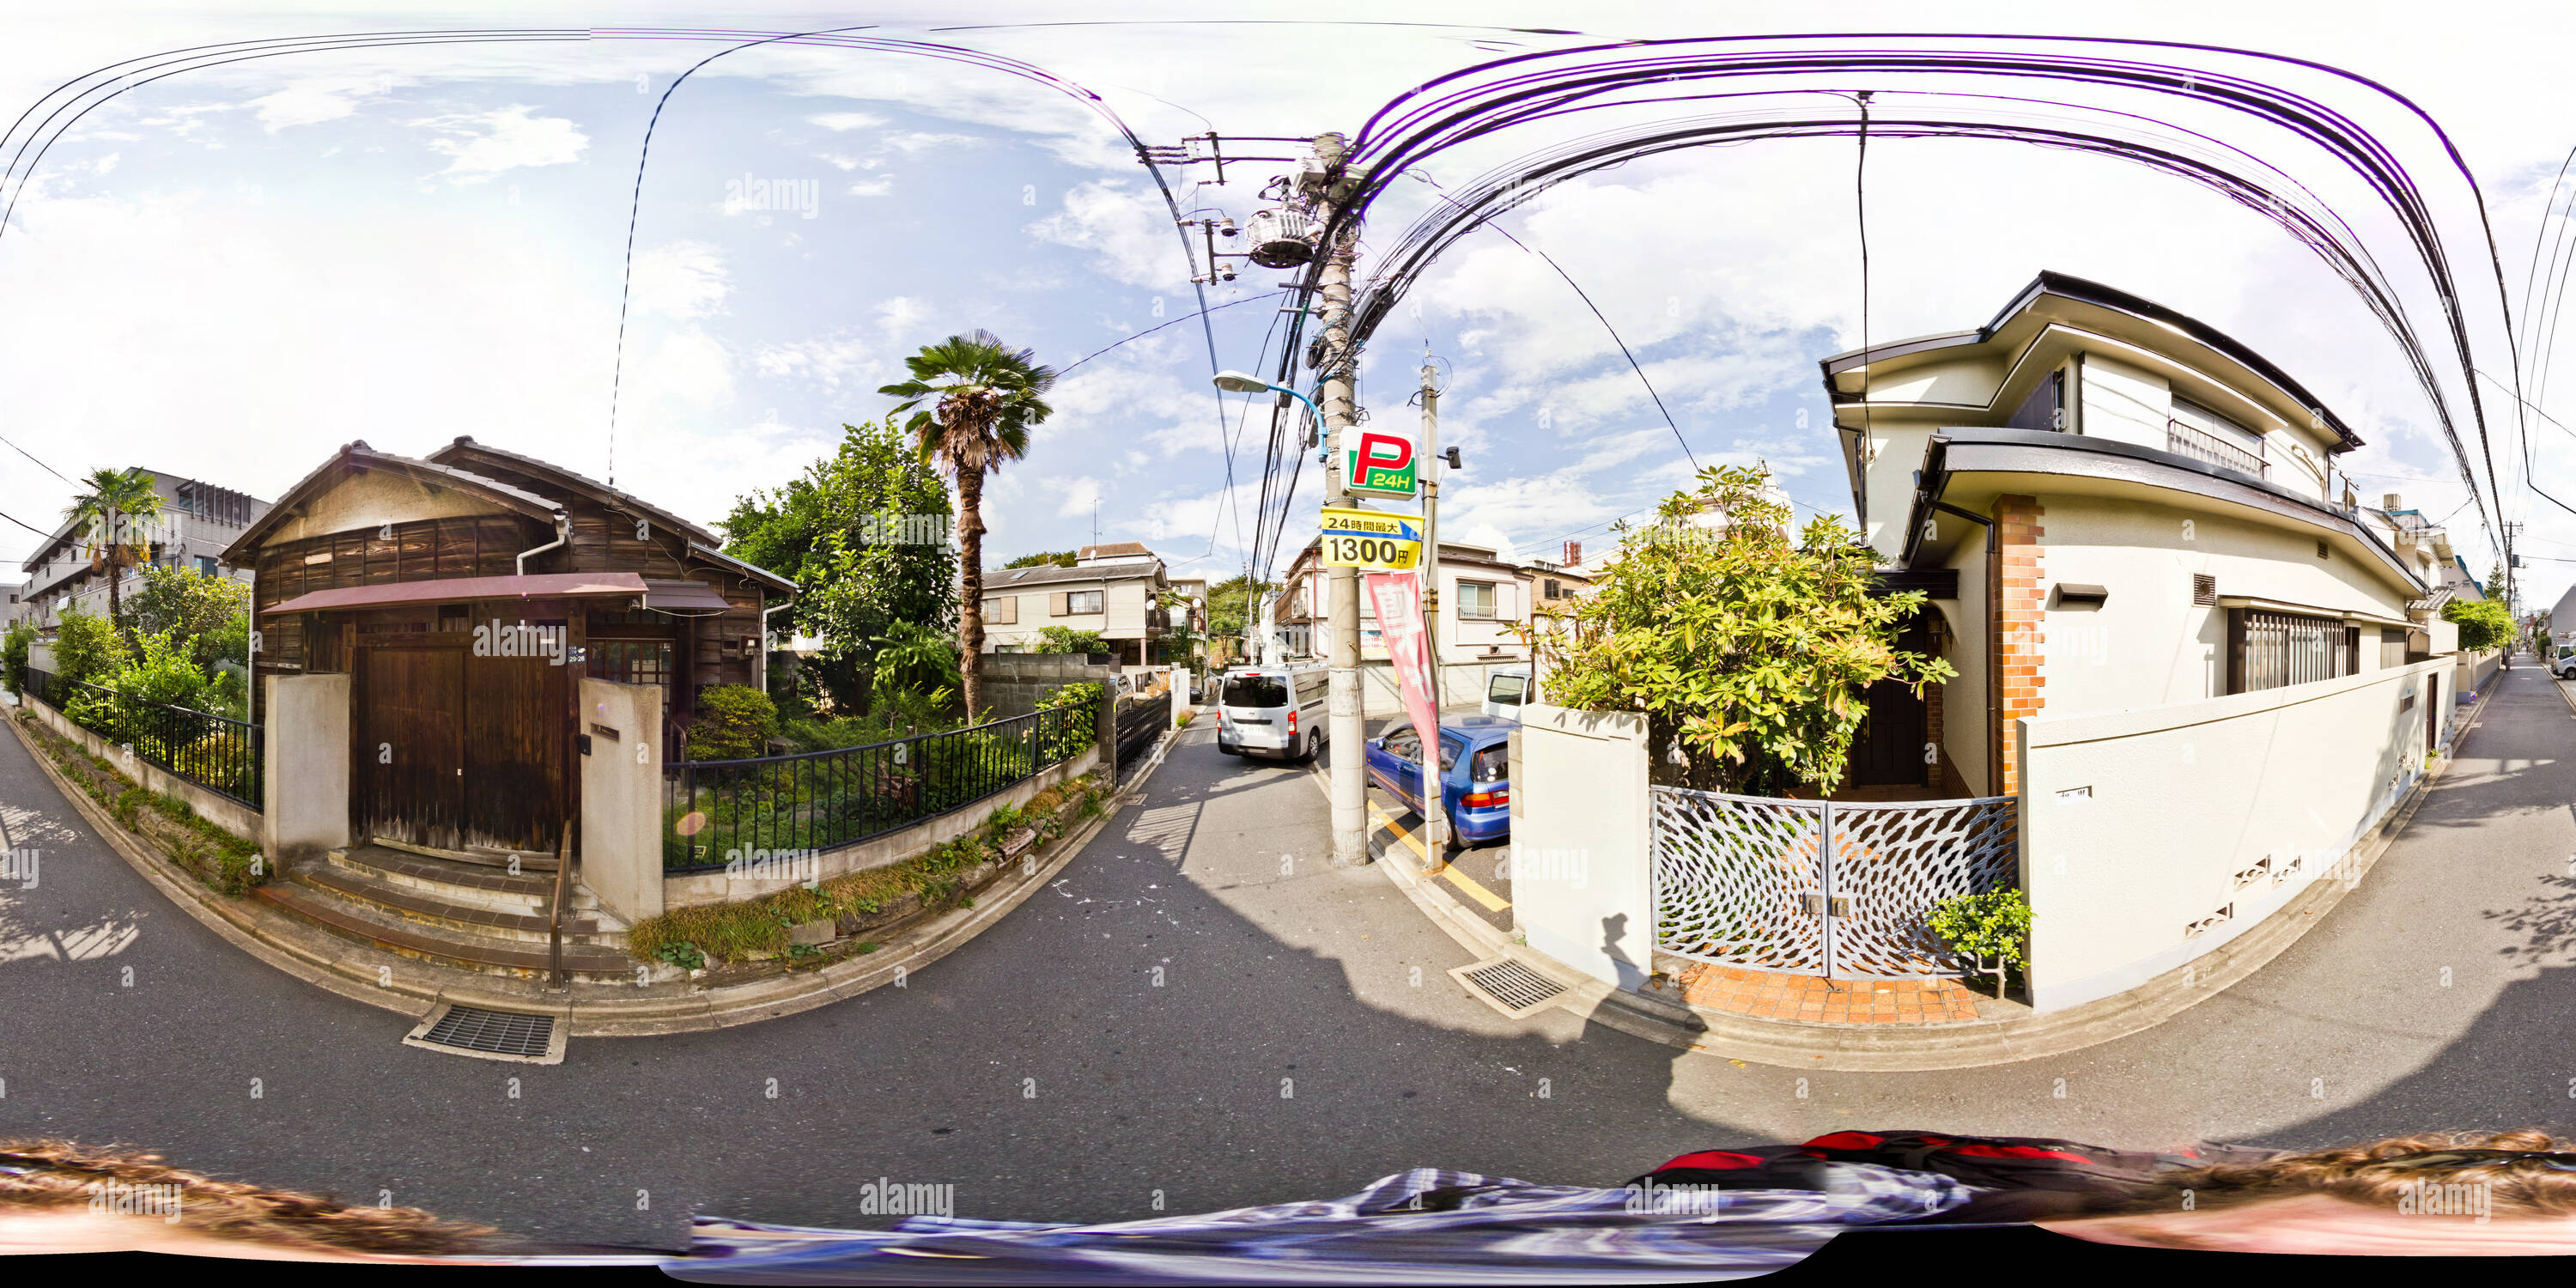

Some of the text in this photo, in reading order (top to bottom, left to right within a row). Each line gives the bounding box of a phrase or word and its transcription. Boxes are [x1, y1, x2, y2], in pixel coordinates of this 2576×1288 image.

[1353, 433, 1412, 484] P
[1373, 473, 1410, 489] 24H
[1328, 518, 1398, 533] 24時間最大
[1330, 538, 1409, 563] 1300円
